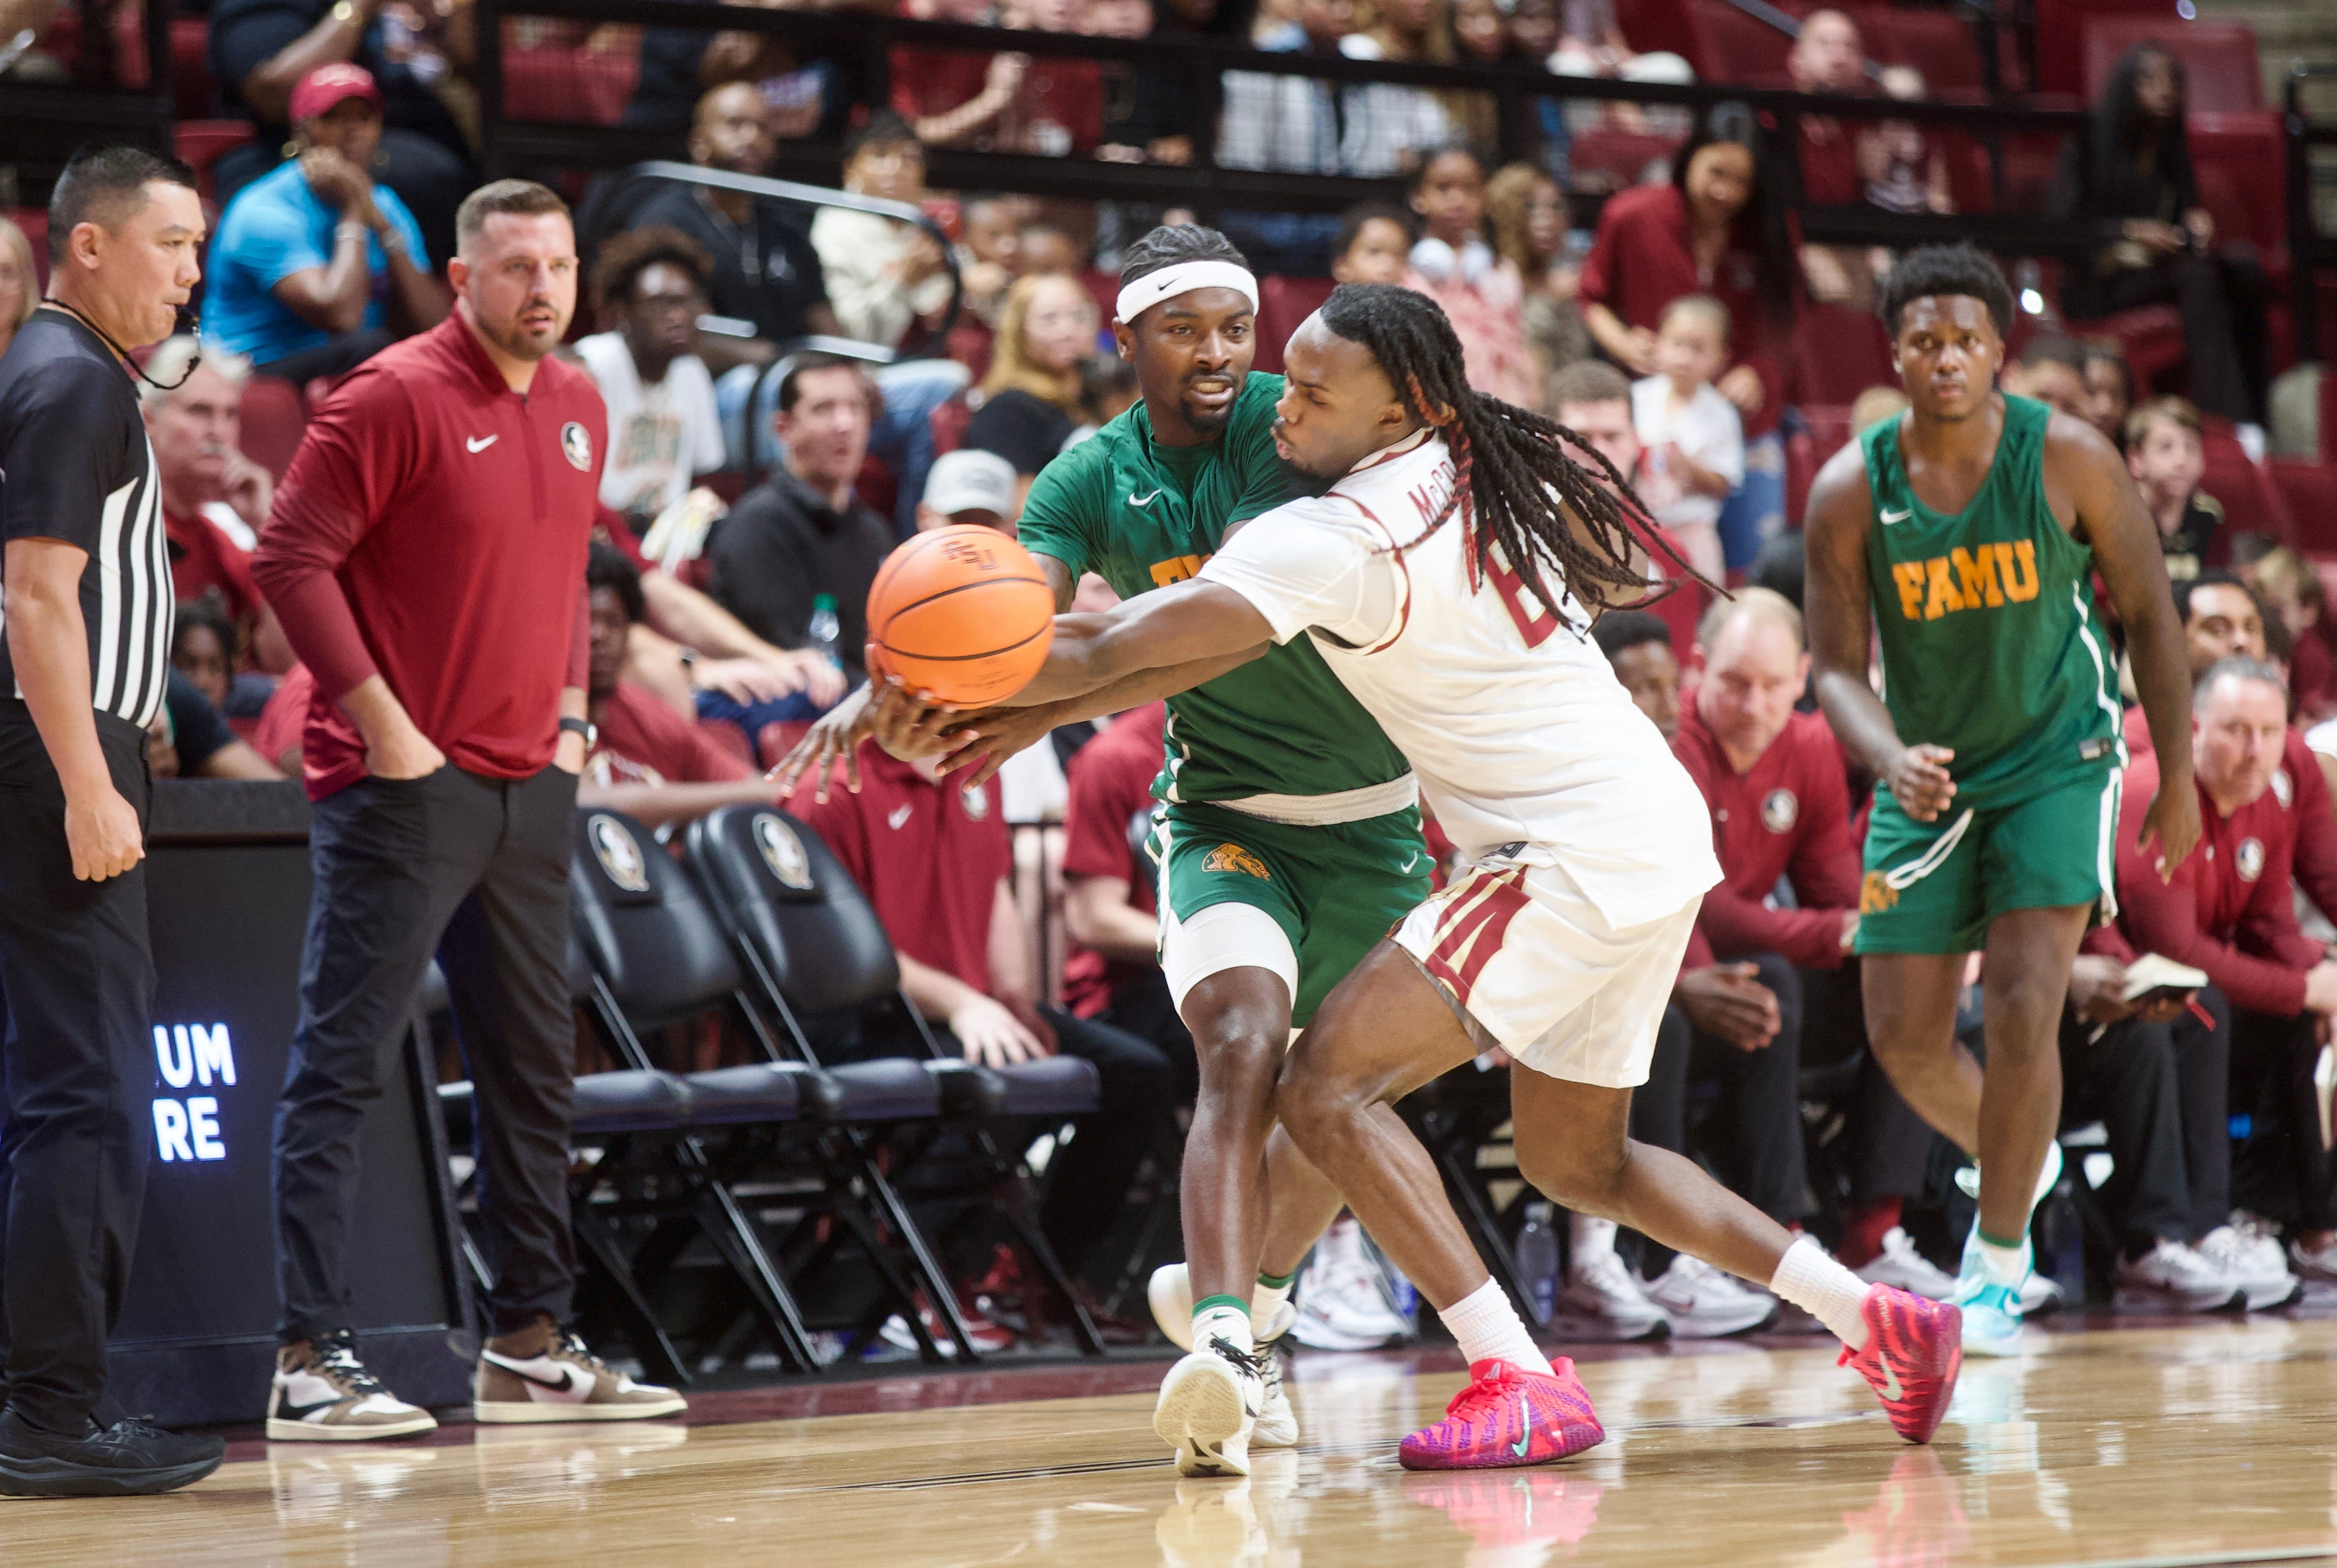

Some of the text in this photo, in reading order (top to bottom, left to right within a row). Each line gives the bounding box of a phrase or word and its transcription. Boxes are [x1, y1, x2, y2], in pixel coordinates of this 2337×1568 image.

[1892, 538, 2039, 621] FAMU
[152, 1023, 236, 1088] UM
[152, 1097, 226, 1163] RE
